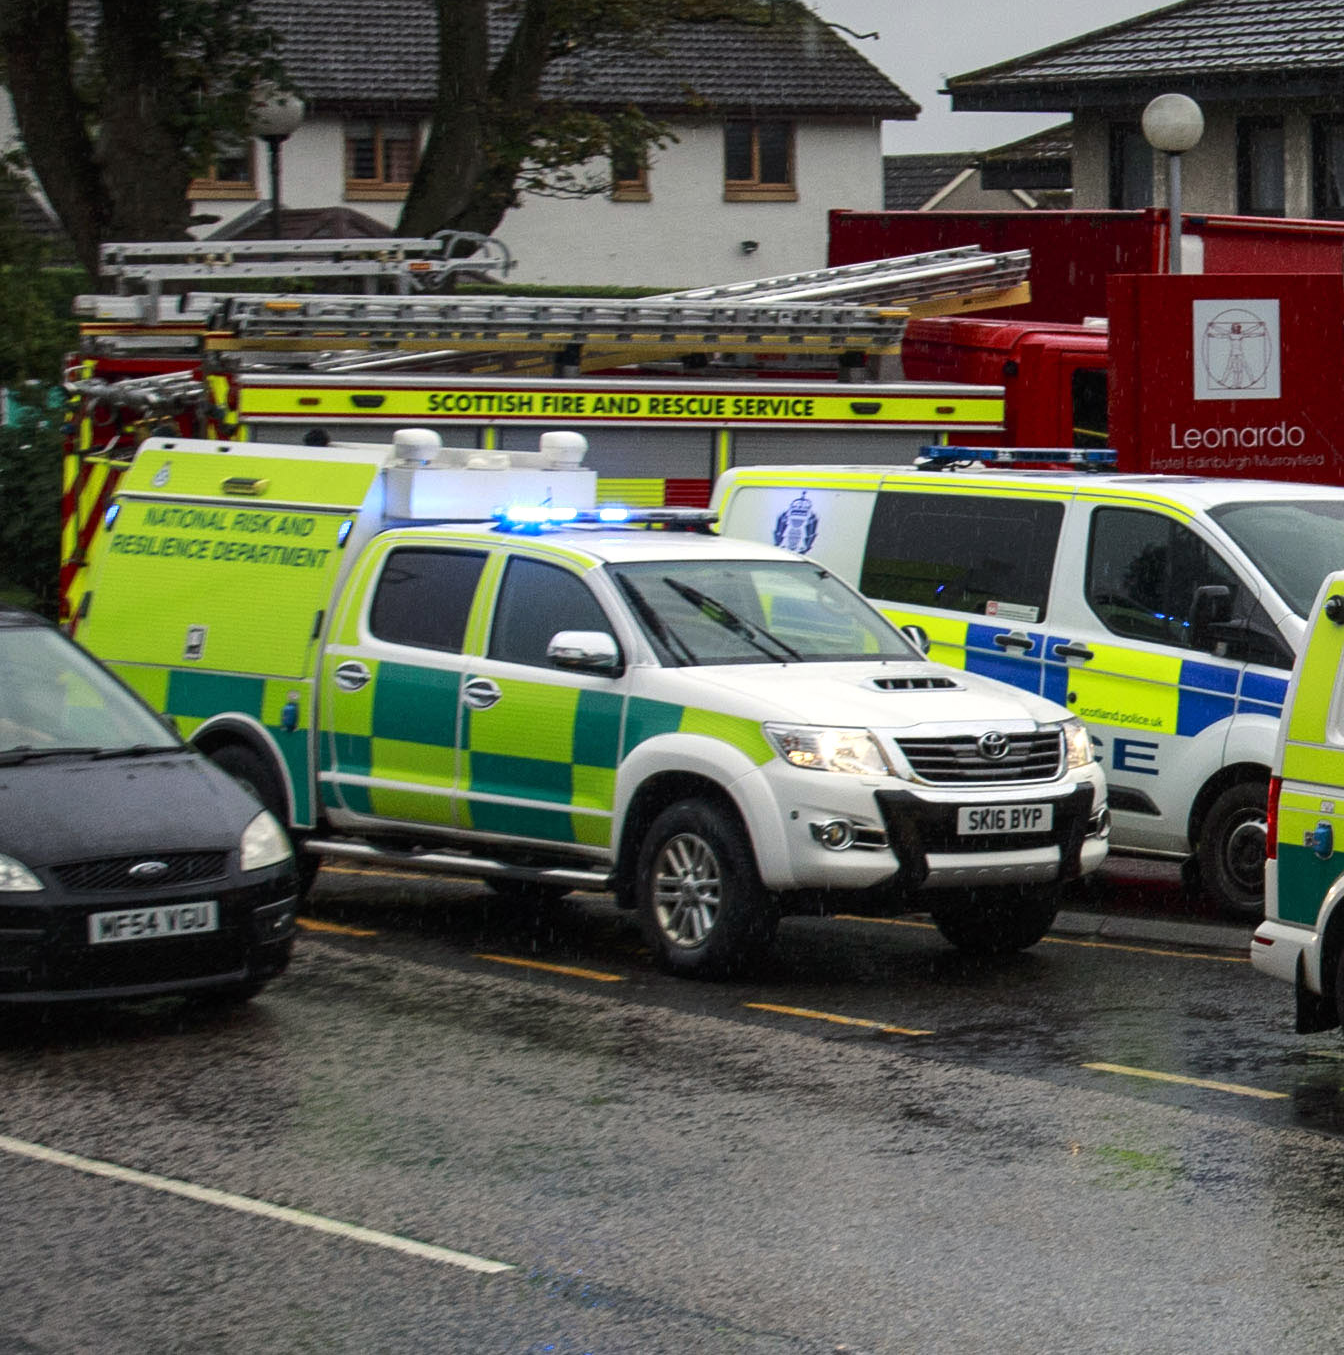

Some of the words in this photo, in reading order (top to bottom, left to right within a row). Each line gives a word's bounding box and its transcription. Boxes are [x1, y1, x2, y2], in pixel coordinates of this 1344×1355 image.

[427, 393, 534, 414] SCOTTISH
[541, 396, 586, 414] FIRE
[592, 397, 640, 415] AND
[648, 397, 726, 416] RESCUE
[733, 398, 814, 417] SERVICE
[1170, 421, 1306, 449] Leonardo
[1150, 455, 1184, 470] Hotel
[1186, 455, 1251, 471] Edinburgh
[1254, 453, 1326, 469] Murrayfield
[142, 507, 228, 531] NATIONAL
[230, 513, 277, 533] RISK
[274, 516, 317, 537] AND
[109, 533, 213, 560] RESILIENCE
[211, 540, 331, 569] DEPARTMENT
[1079, 707, 1163, 727] scotland.police.uk
[968, 808, 1006, 831] SK16
[1010, 807, 1043, 830] BYP
